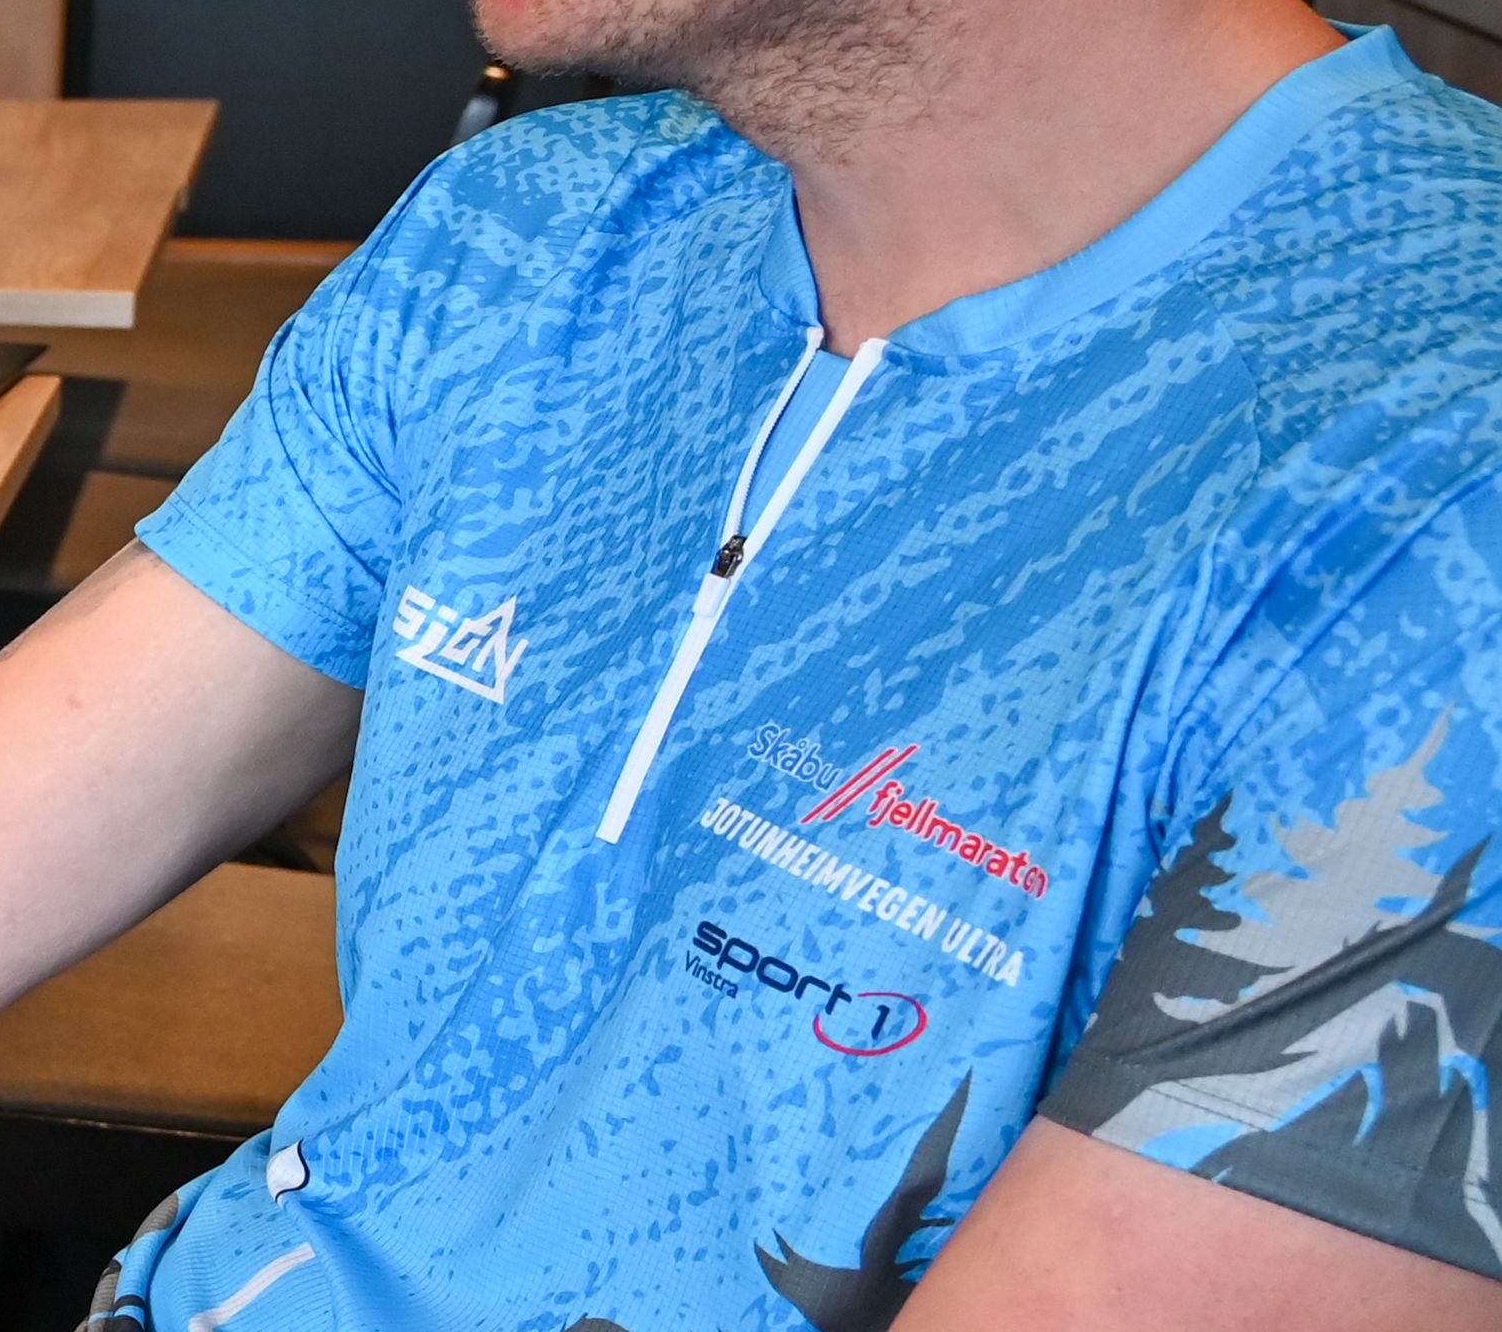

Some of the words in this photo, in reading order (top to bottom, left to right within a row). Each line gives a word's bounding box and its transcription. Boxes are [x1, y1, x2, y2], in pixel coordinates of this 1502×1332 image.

[748, 720, 841, 792] Skåbu
[867, 780, 1049, 899] fjellmaraton
[699, 797, 948, 941] JOTUNHEIMVEGEN
[941, 917, 1026, 988] ULTRA
[684, 949, 740, 1000] Vinstra
[692, 920, 853, 1016] sport
[871, 1003, 891, 1041] 1
